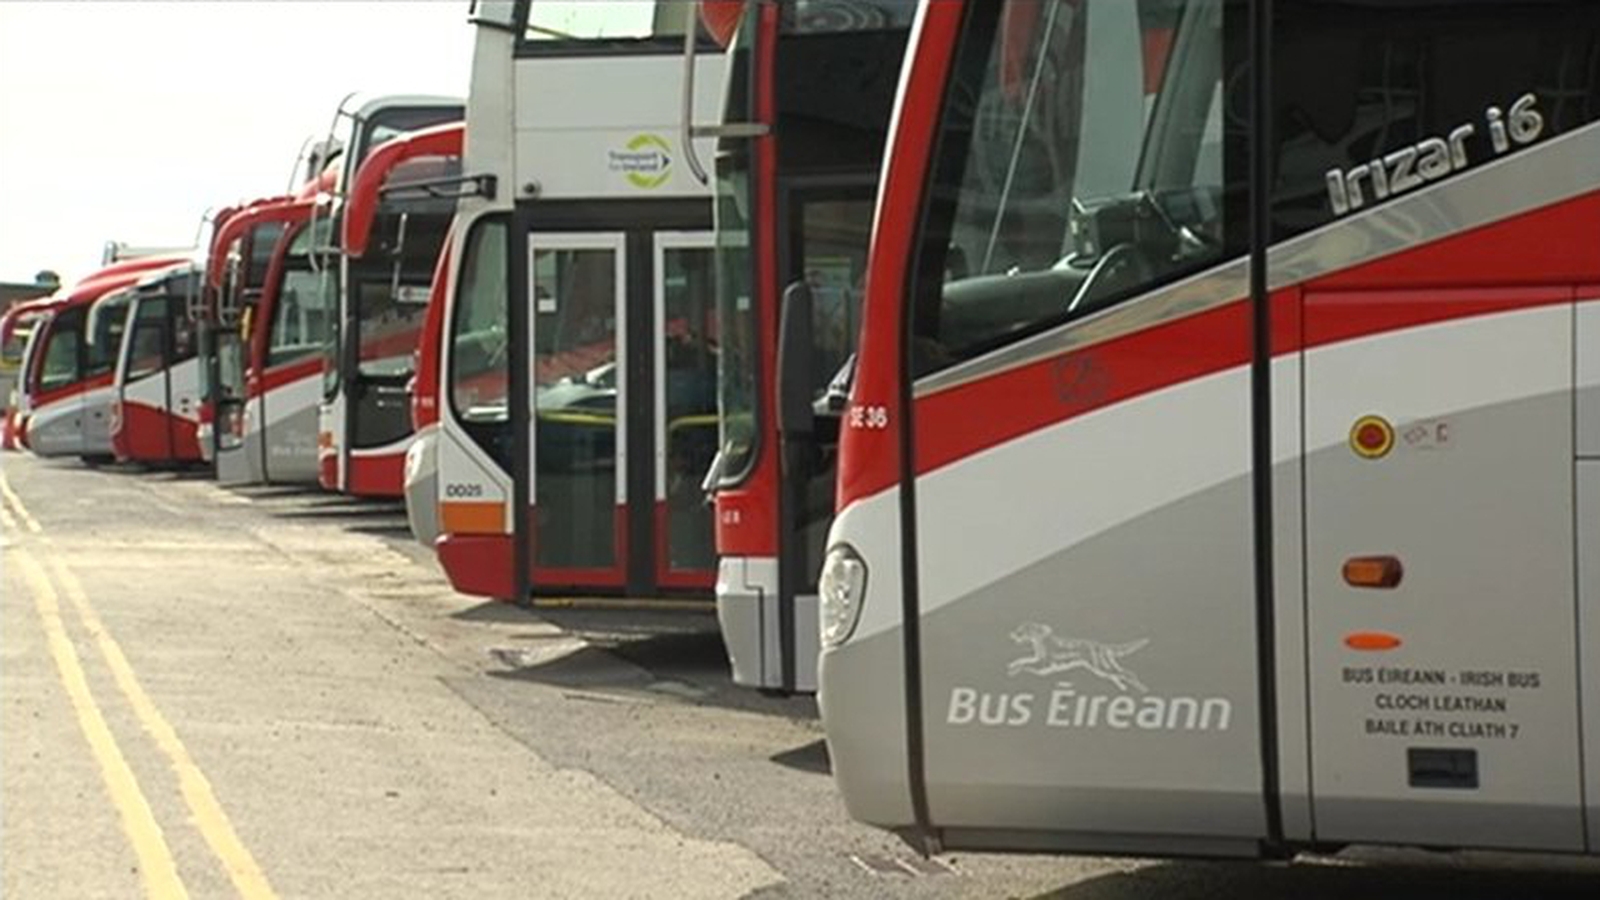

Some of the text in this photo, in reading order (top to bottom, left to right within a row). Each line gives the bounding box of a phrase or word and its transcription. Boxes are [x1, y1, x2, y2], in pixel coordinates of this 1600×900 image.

[1325, 92, 1544, 216] Irizar i6
[866, 406, 887, 429] 36
[1342, 667, 1374, 684] BUS
[1459, 670, 1503, 687] IRISH
[1508, 671, 1541, 688] BUS
[946, 686, 1035, 726] Bus
[1375, 693, 1507, 712] CLOCH LEATHAN
[1365, 718, 1409, 735] BAILE
[1450, 721, 1504, 738] CLIATH
[1508, 724, 1519, 739] 7
